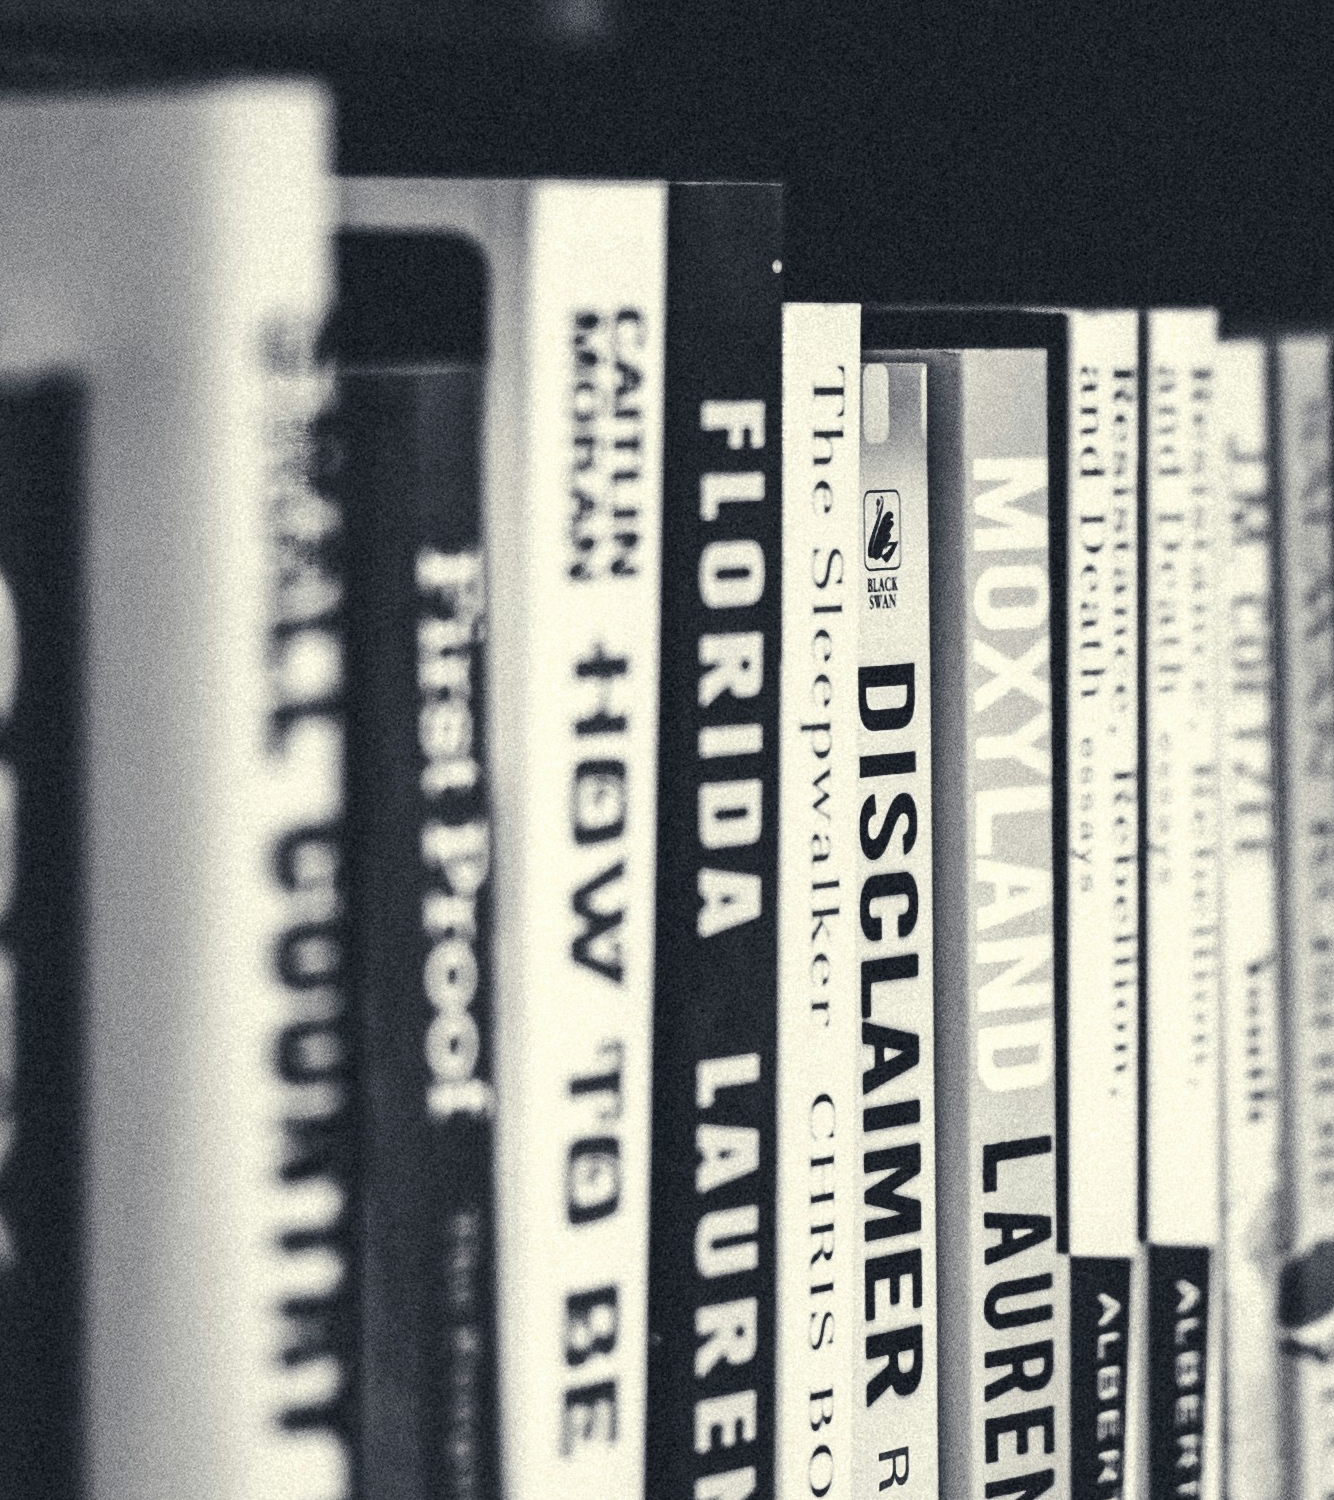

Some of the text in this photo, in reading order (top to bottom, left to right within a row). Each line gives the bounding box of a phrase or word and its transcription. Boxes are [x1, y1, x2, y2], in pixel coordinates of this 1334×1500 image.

[566, 308, 604, 583] MORAN
[608, 308, 649, 578] CAITLIN
[808, 364, 849, 517] The
[1153, 365, 1184, 479] and
[696, 398, 765, 939] FLORIDA
[867, 576, 899, 593] BLACK
[869, 594, 897, 610] SWAN
[1069, 365, 1107, 896] and Death essays
[1153, 511, 1185, 696] Death
[415, 546, 497, 1116] First Proof
[569, 638, 631, 988] HOW
[795, 545, 848, 1032] Sleepwalker
[971, 455, 1055, 1091] MOXYLAND
[1106, 365, 1139, 1100] Resistance, Rebellion,
[565, 1038, 627, 1228] TO
[856, 661, 925, 1408] DISCLAIMER
[805, 1089, 838, 1355] CHRIS
[556, 1282, 623, 1458] BE
[1172, 1278, 1202, 1500] ALBERT
